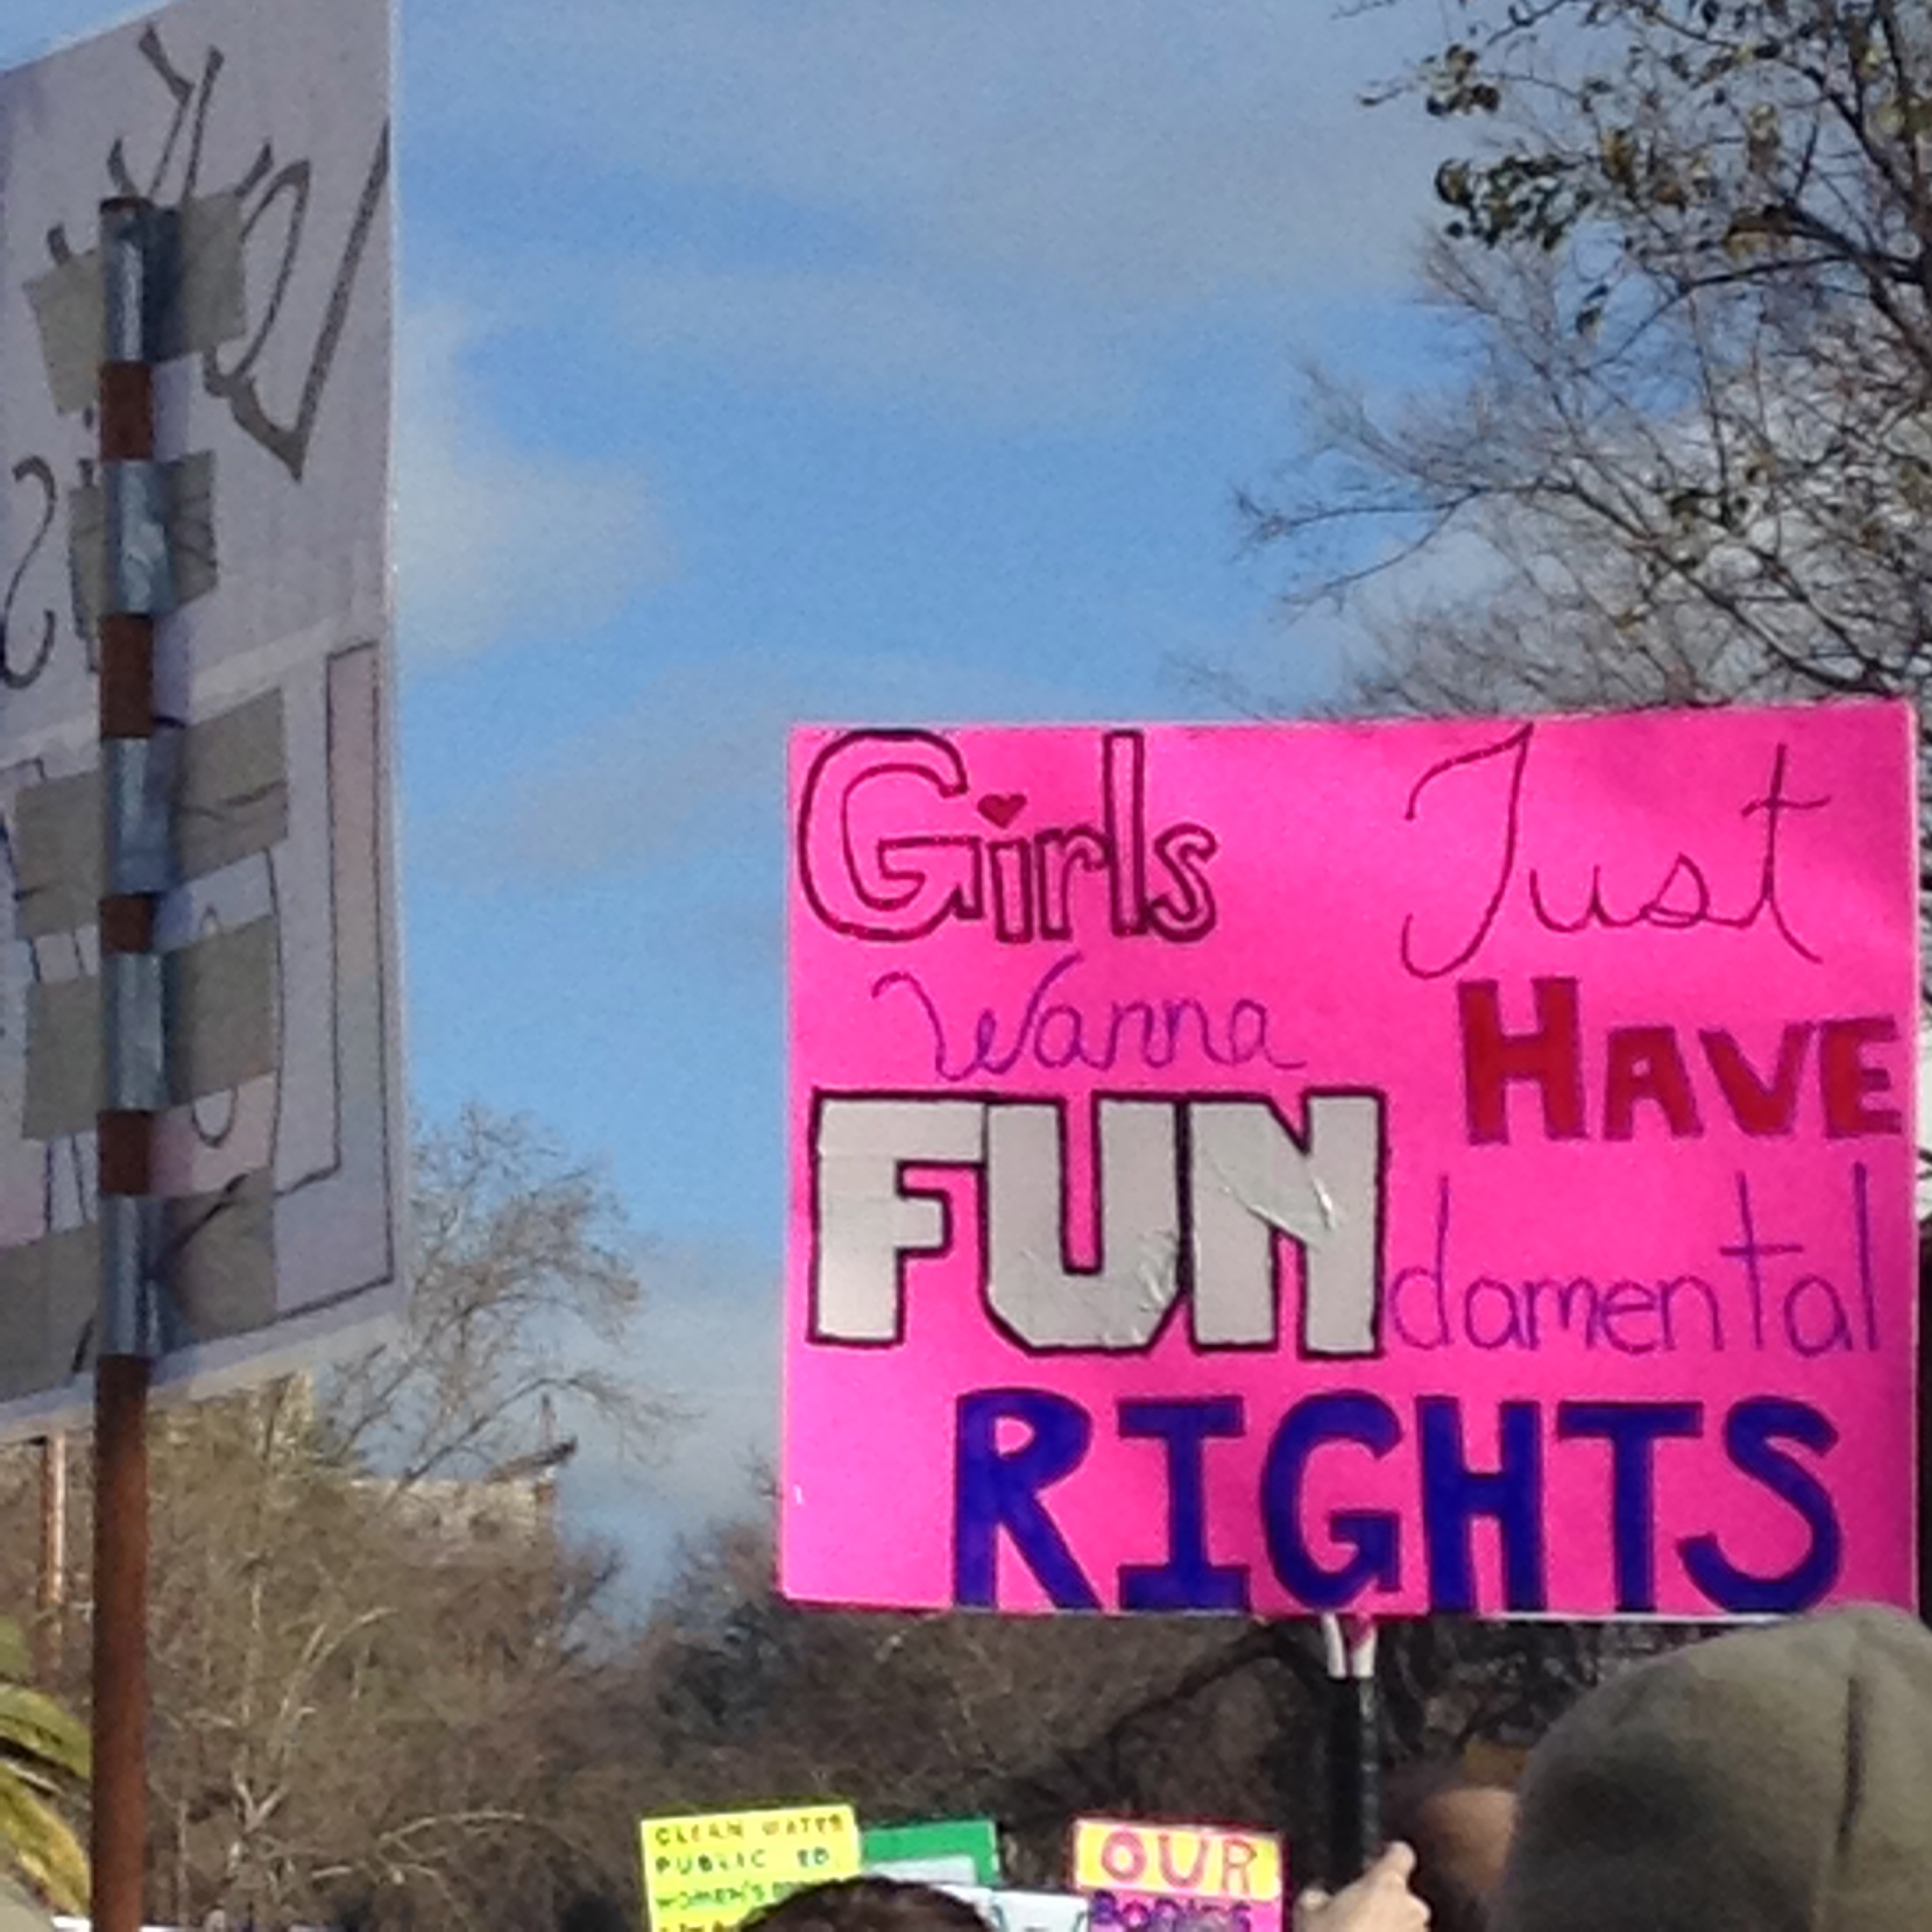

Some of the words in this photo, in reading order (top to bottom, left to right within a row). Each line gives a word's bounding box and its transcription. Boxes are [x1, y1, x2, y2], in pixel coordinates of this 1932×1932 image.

[799, 727, 1217, 943] Girls
[1402, 721, 1833, 979] Just
[870, 950, 1307, 1082] Wanna
[1457, 976, 1903, 1146] HAVE
[952, 1386, 1843, 1614] RIGHTS
[655, 1821, 743, 1845] CLEAN
[761, 1812, 844, 1836] WATER
[655, 1848, 766, 1874] PUBLIC
[1100, 1829, 1258, 1895] OUR
